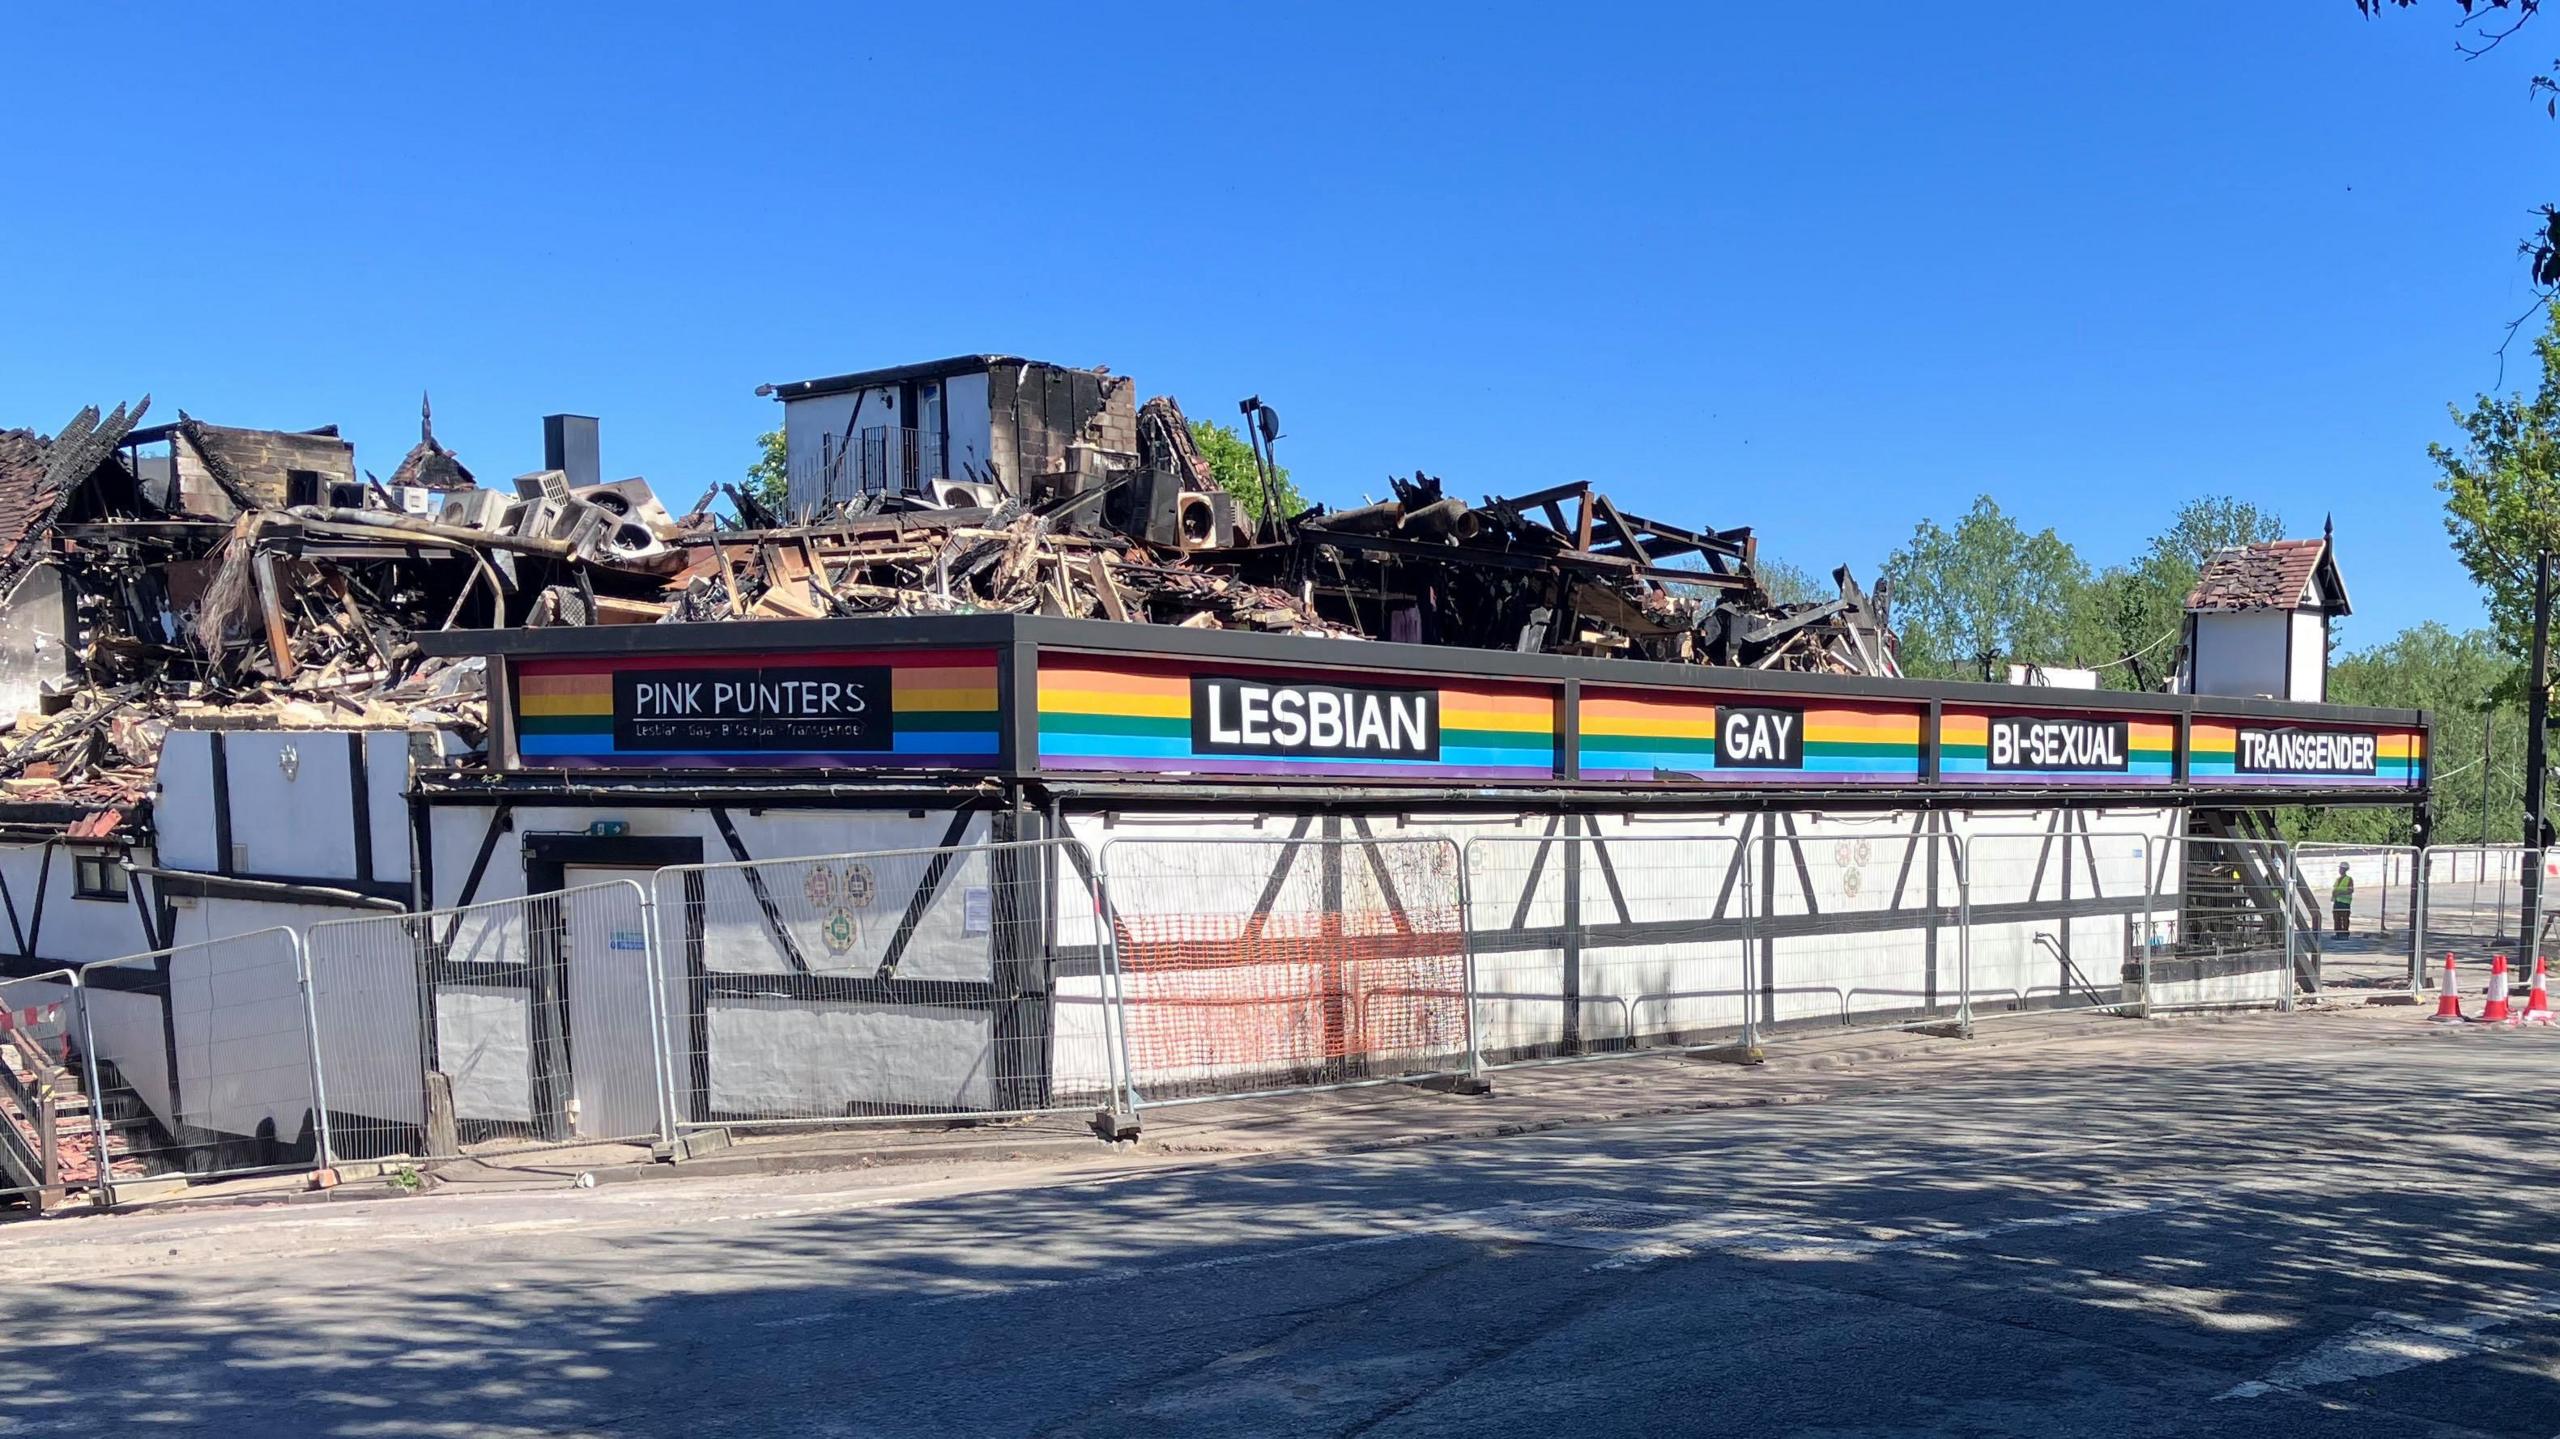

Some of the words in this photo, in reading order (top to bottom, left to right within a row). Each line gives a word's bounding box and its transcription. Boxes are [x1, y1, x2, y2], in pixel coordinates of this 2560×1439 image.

[636, 682, 702, 715] PINK
[715, 681, 866, 714] PUNTERS
[1208, 685, 1426, 751] LESBIAN
[735, 723, 776, 737] Sexua
[1725, 713, 1794, 760] GAY
[1992, 723, 2123, 767] BI-SEXUAL
[2240, 732, 2375, 771] TRANSGENDER
